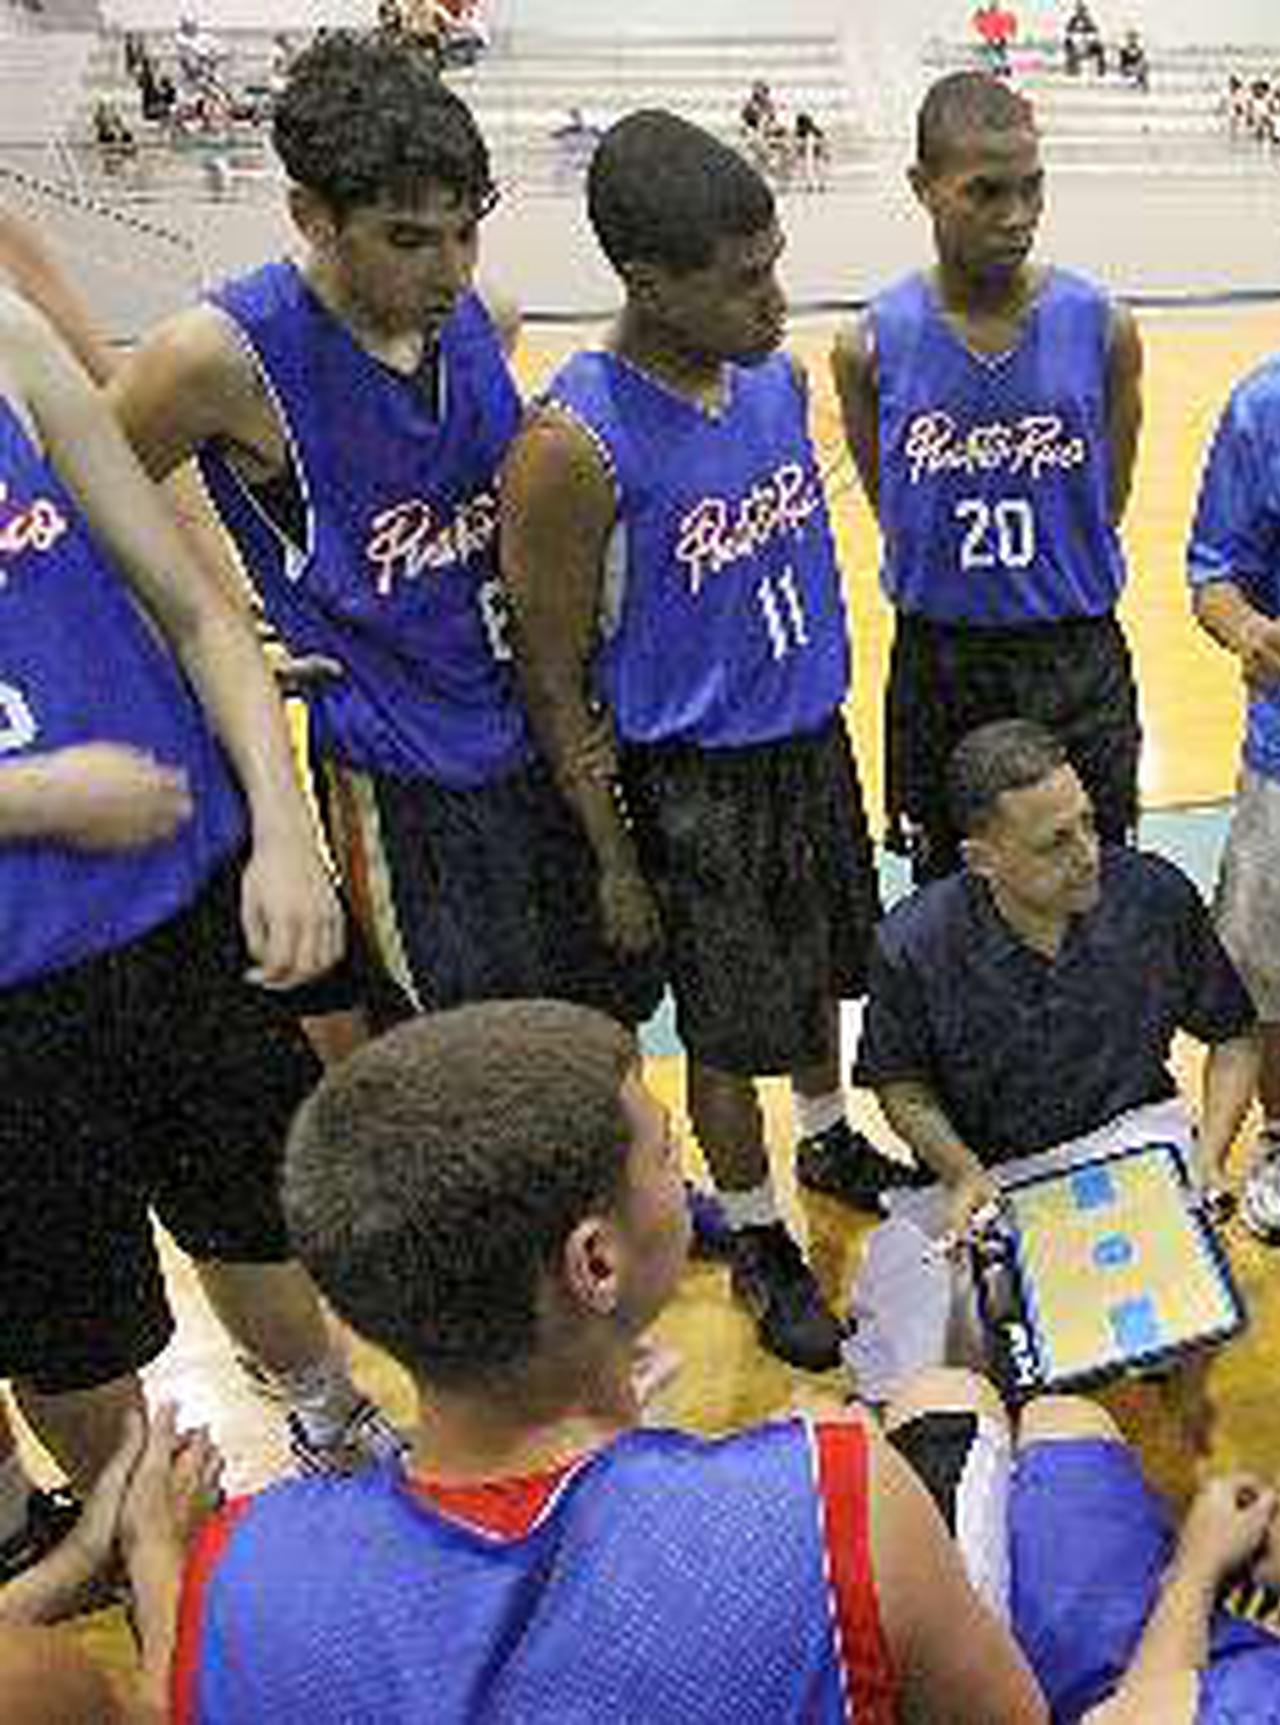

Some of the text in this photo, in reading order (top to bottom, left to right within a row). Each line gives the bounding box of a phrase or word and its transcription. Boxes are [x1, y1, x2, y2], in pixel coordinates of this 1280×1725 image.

[905, 411, 1085, 485] Puerto Rico
[954, 498, 1036, 571] 20
[757, 565, 809, 660] 11
